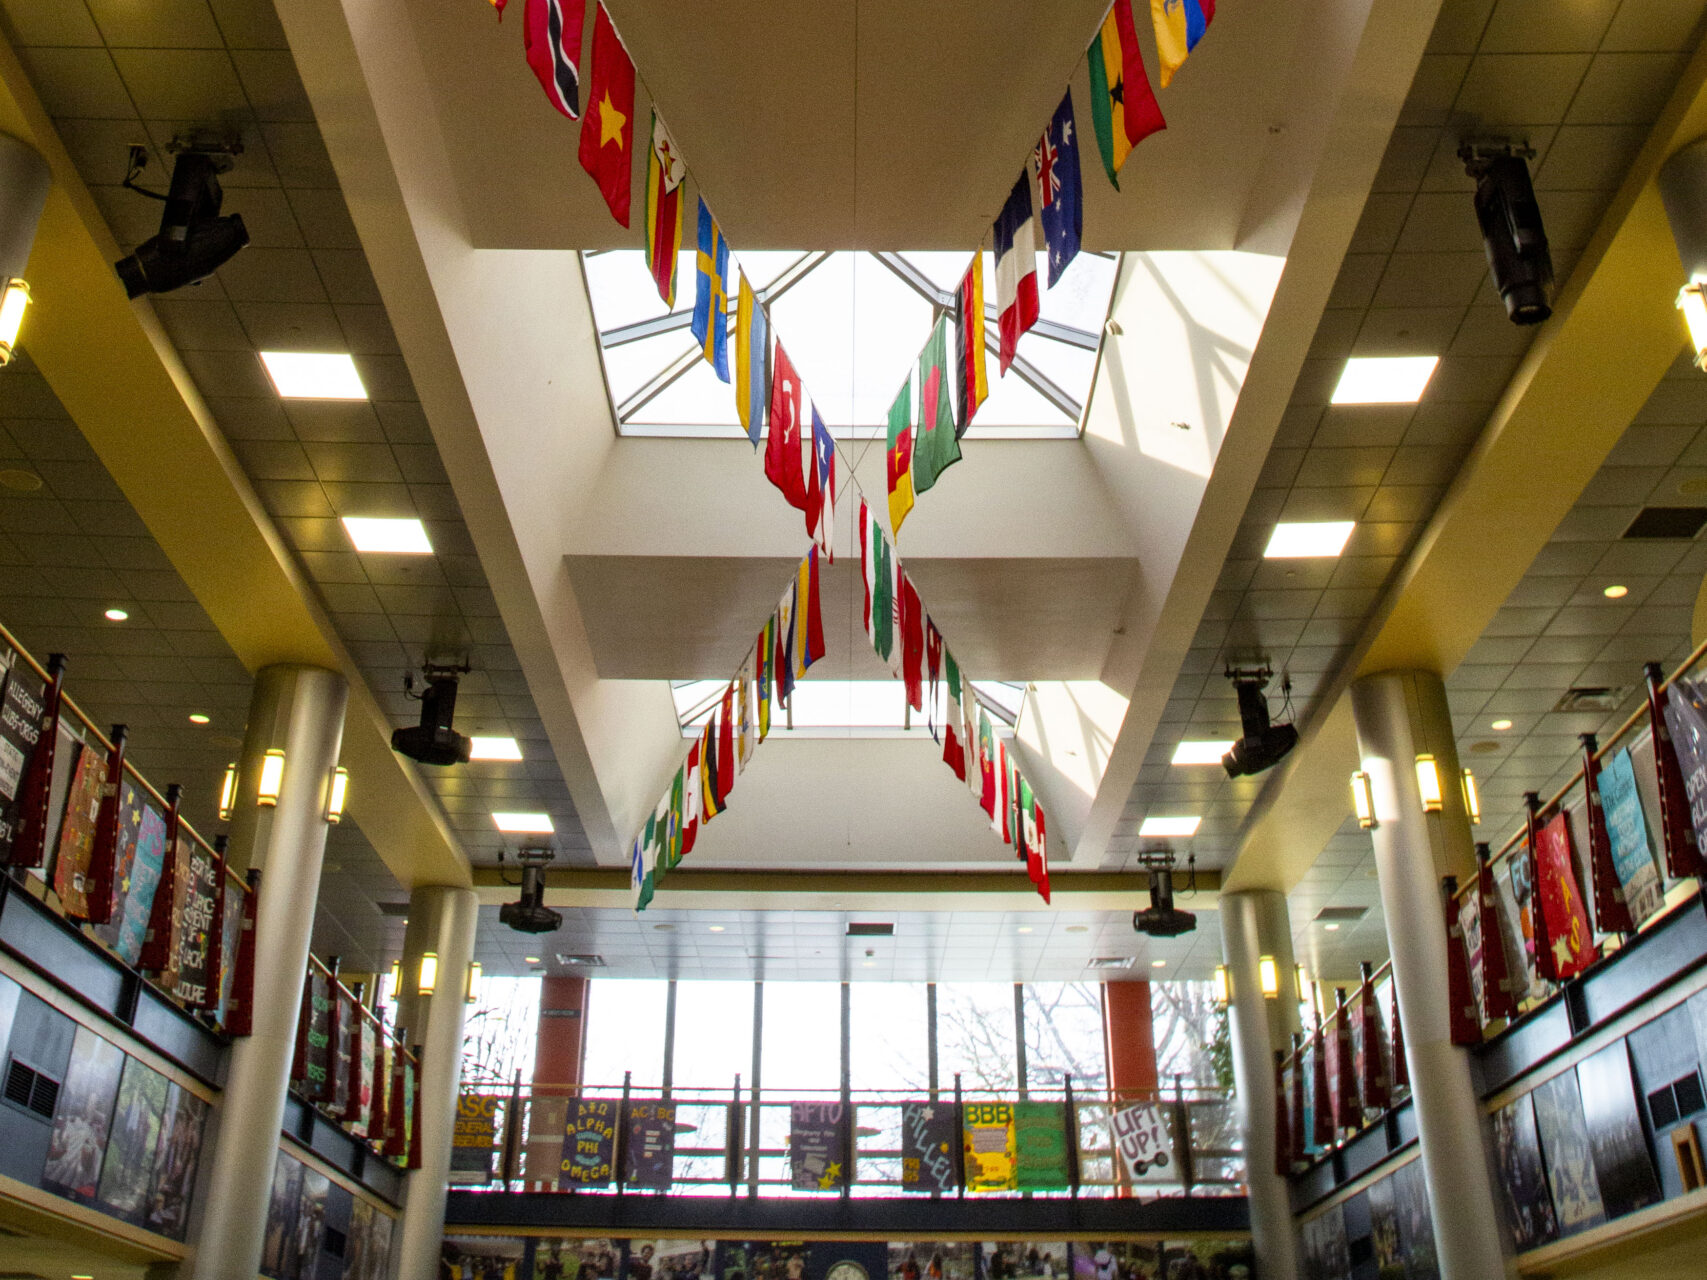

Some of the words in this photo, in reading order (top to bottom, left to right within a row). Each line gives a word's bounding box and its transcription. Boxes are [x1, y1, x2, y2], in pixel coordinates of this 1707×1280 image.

[966, 1103, 1012, 1125] BBB
[1113, 1102, 1158, 1137] LIFT
[566, 1118, 614, 1140] ALPHA
[577, 1140, 599, 1153] PHI
[903, 1103, 952, 1191] HILLEL
[1120, 1125, 1161, 1160] UP!
[561, 1159, 610, 1183] OMEGA
